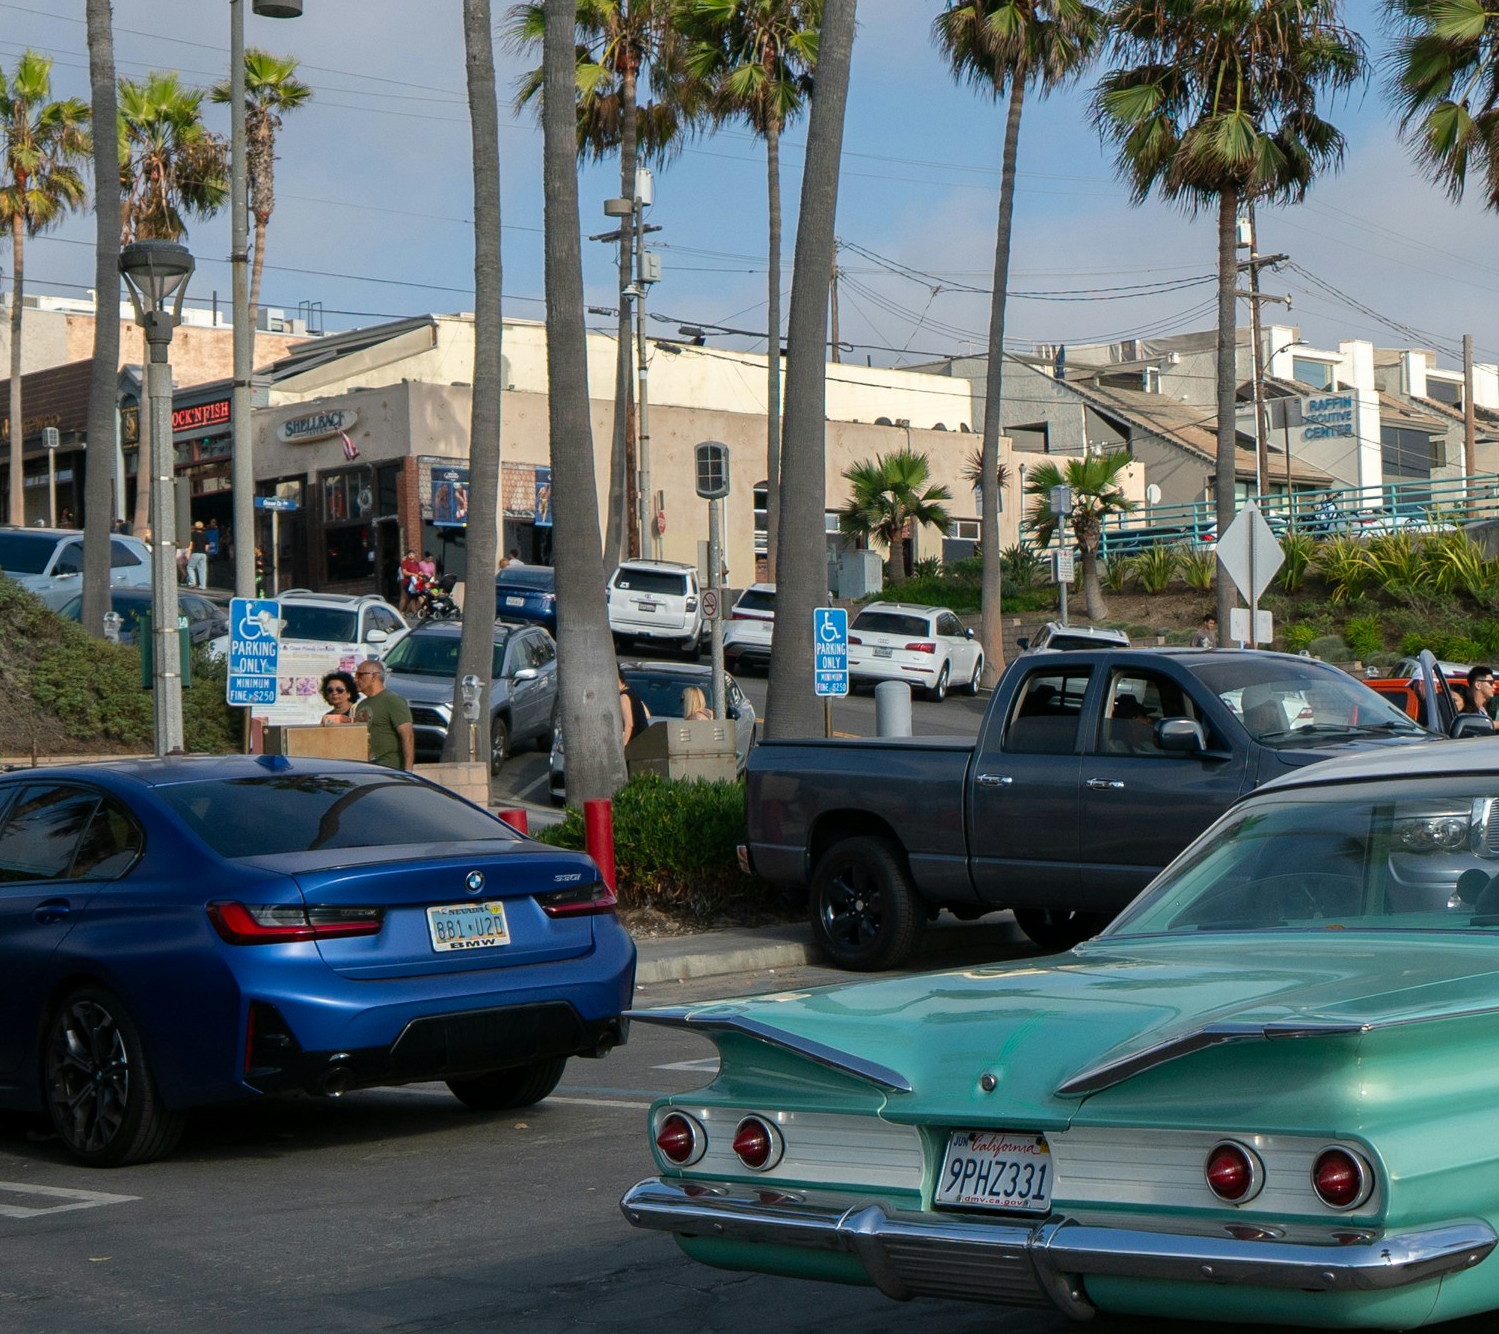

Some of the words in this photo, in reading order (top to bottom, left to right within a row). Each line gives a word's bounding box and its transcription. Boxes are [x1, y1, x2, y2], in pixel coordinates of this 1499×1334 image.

[1302, 411, 1351, 424] ECUTIVE
[1305, 423, 1351, 439] CENTER
[231, 640, 276, 657] PARKING
[816, 643, 845, 655] PARKING
[239, 657, 268, 673] ONLY
[822, 657, 841, 668] ONLY
[236, 678, 269, 689] MINIMUM
[230, 690, 247, 701] FINE
[253, 690, 274, 702] $250
[448, 906, 485, 916] NEVADA
[450, 938, 496, 949] BMW
[953, 1135, 969, 1147] JUN
[971, 1133, 1041, 1158] California
[944, 1157, 1047, 1201] 9PHZ331
